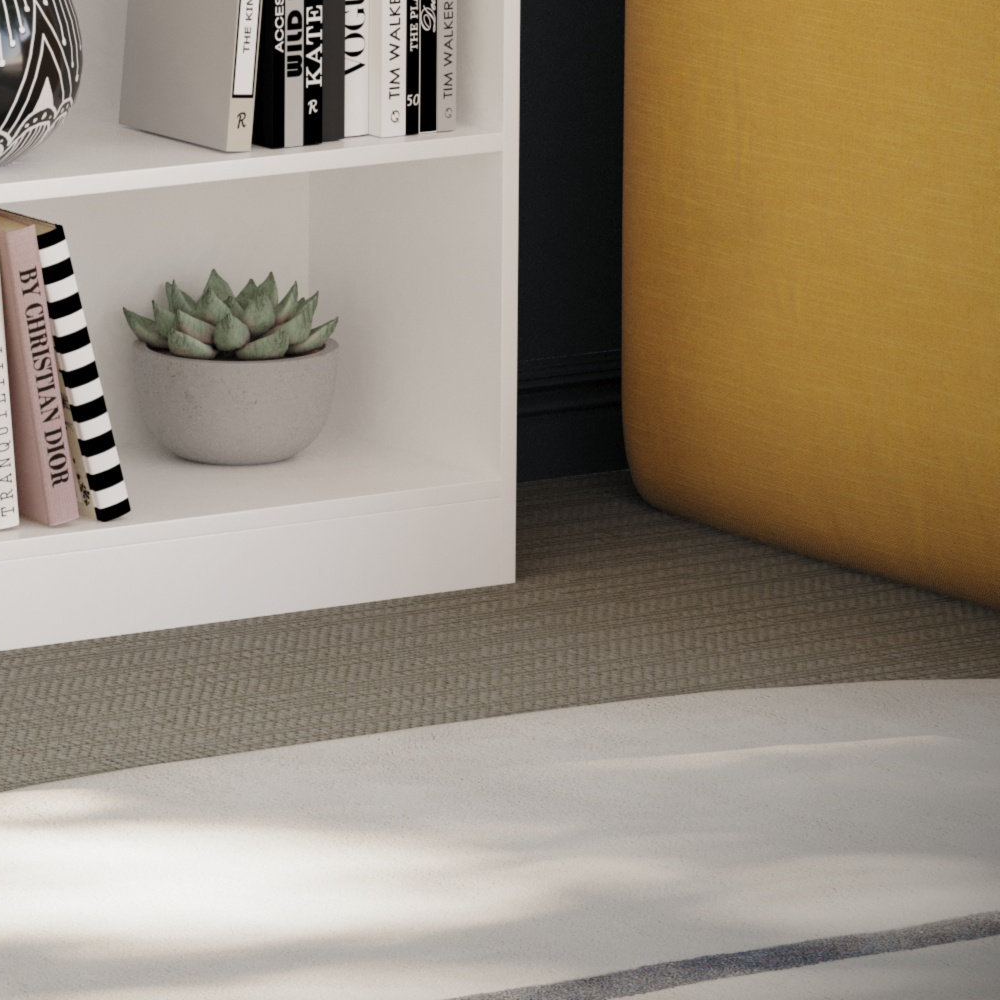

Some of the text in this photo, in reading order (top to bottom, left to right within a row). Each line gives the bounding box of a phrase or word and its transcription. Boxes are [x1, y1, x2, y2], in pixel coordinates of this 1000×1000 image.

[242, 26, 252, 54] THE
[286, 10, 303, 78] WILD
[305, 4, 323, 88] KATE
[409, 22, 419, 52] THE
[443, 1, 454, 67] WALKER
[388, 67, 401, 100] TIM
[406, 93, 420, 107] 50
[443, 72, 454, 99] TIM
[19, 265, 70, 488] BY CHRISTIAN DIOR
